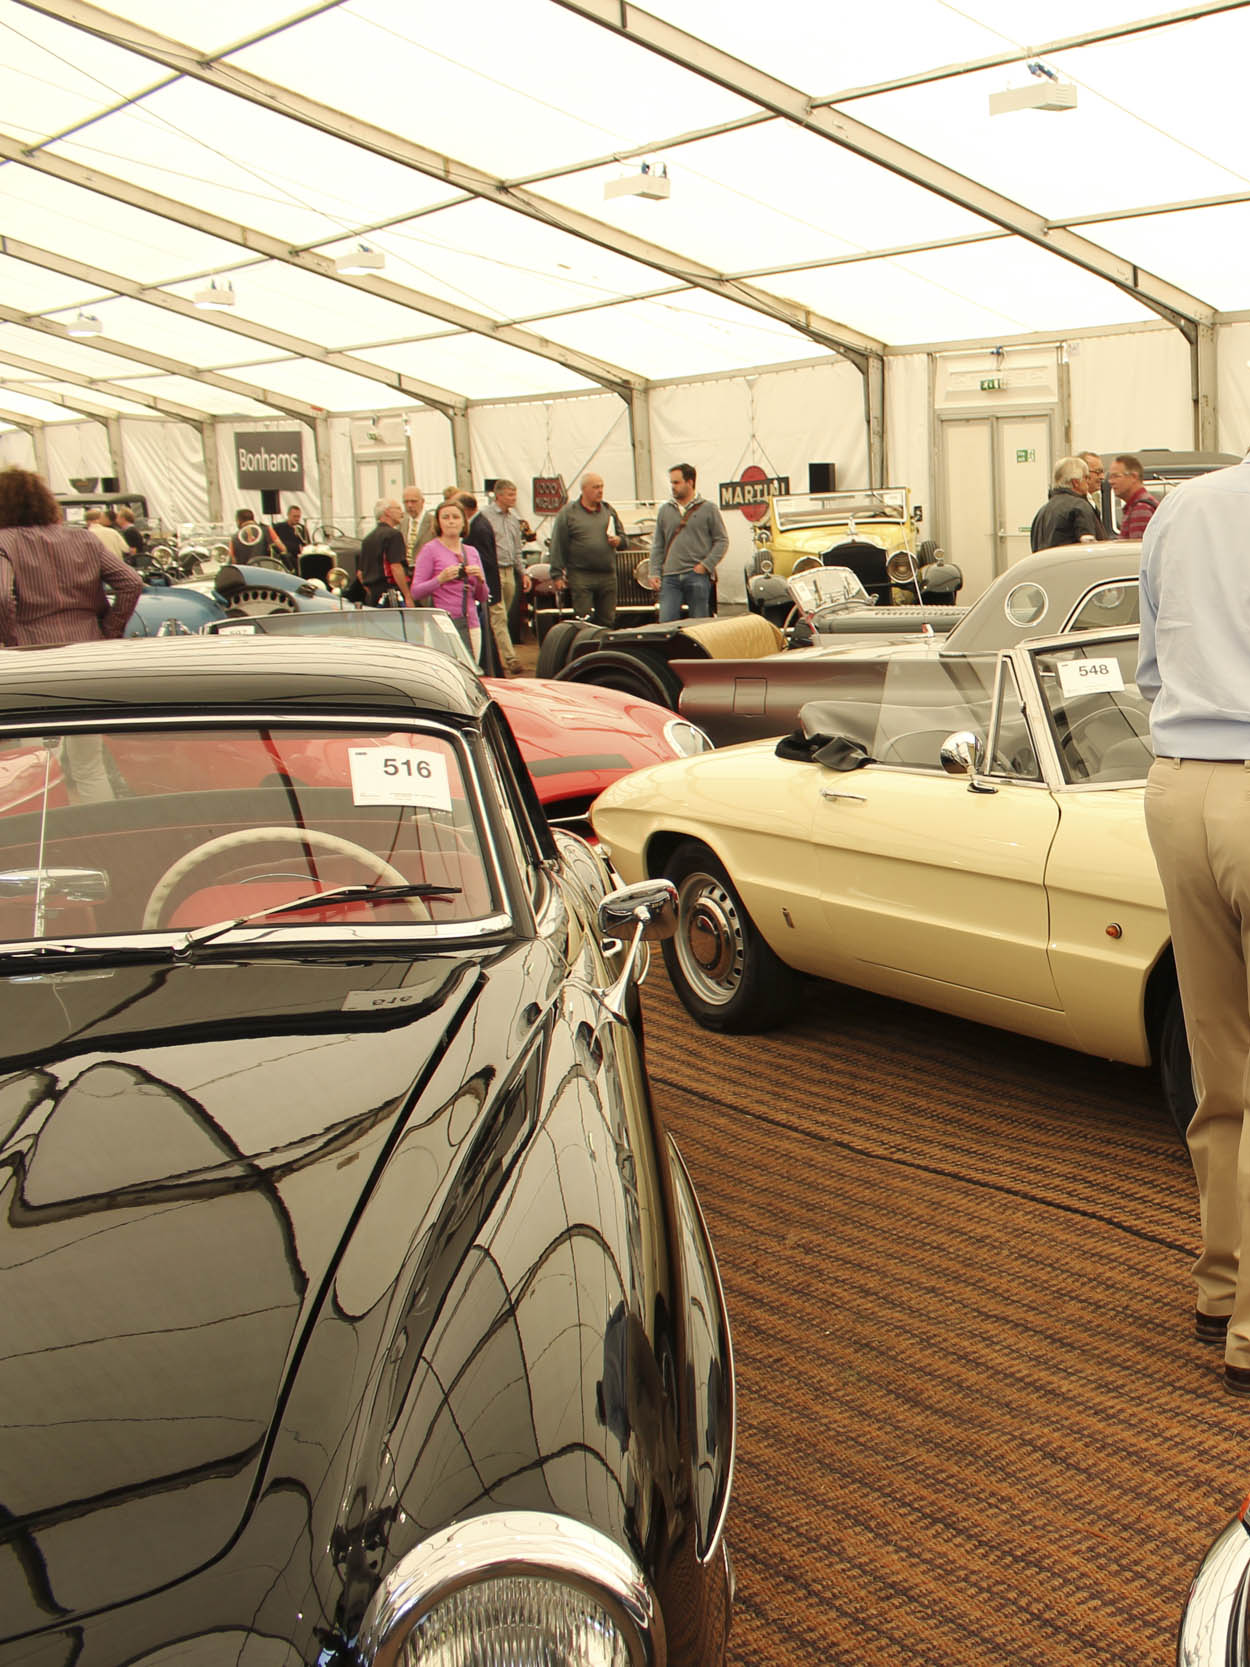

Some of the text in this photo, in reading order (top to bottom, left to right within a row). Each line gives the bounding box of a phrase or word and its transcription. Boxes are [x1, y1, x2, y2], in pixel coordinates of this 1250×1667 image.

[238, 447, 299, 472] Bonhams
[721, 482, 786, 506] MARTINI
[1078, 663, 1110, 677] 548
[383, 758, 432, 779] 516
